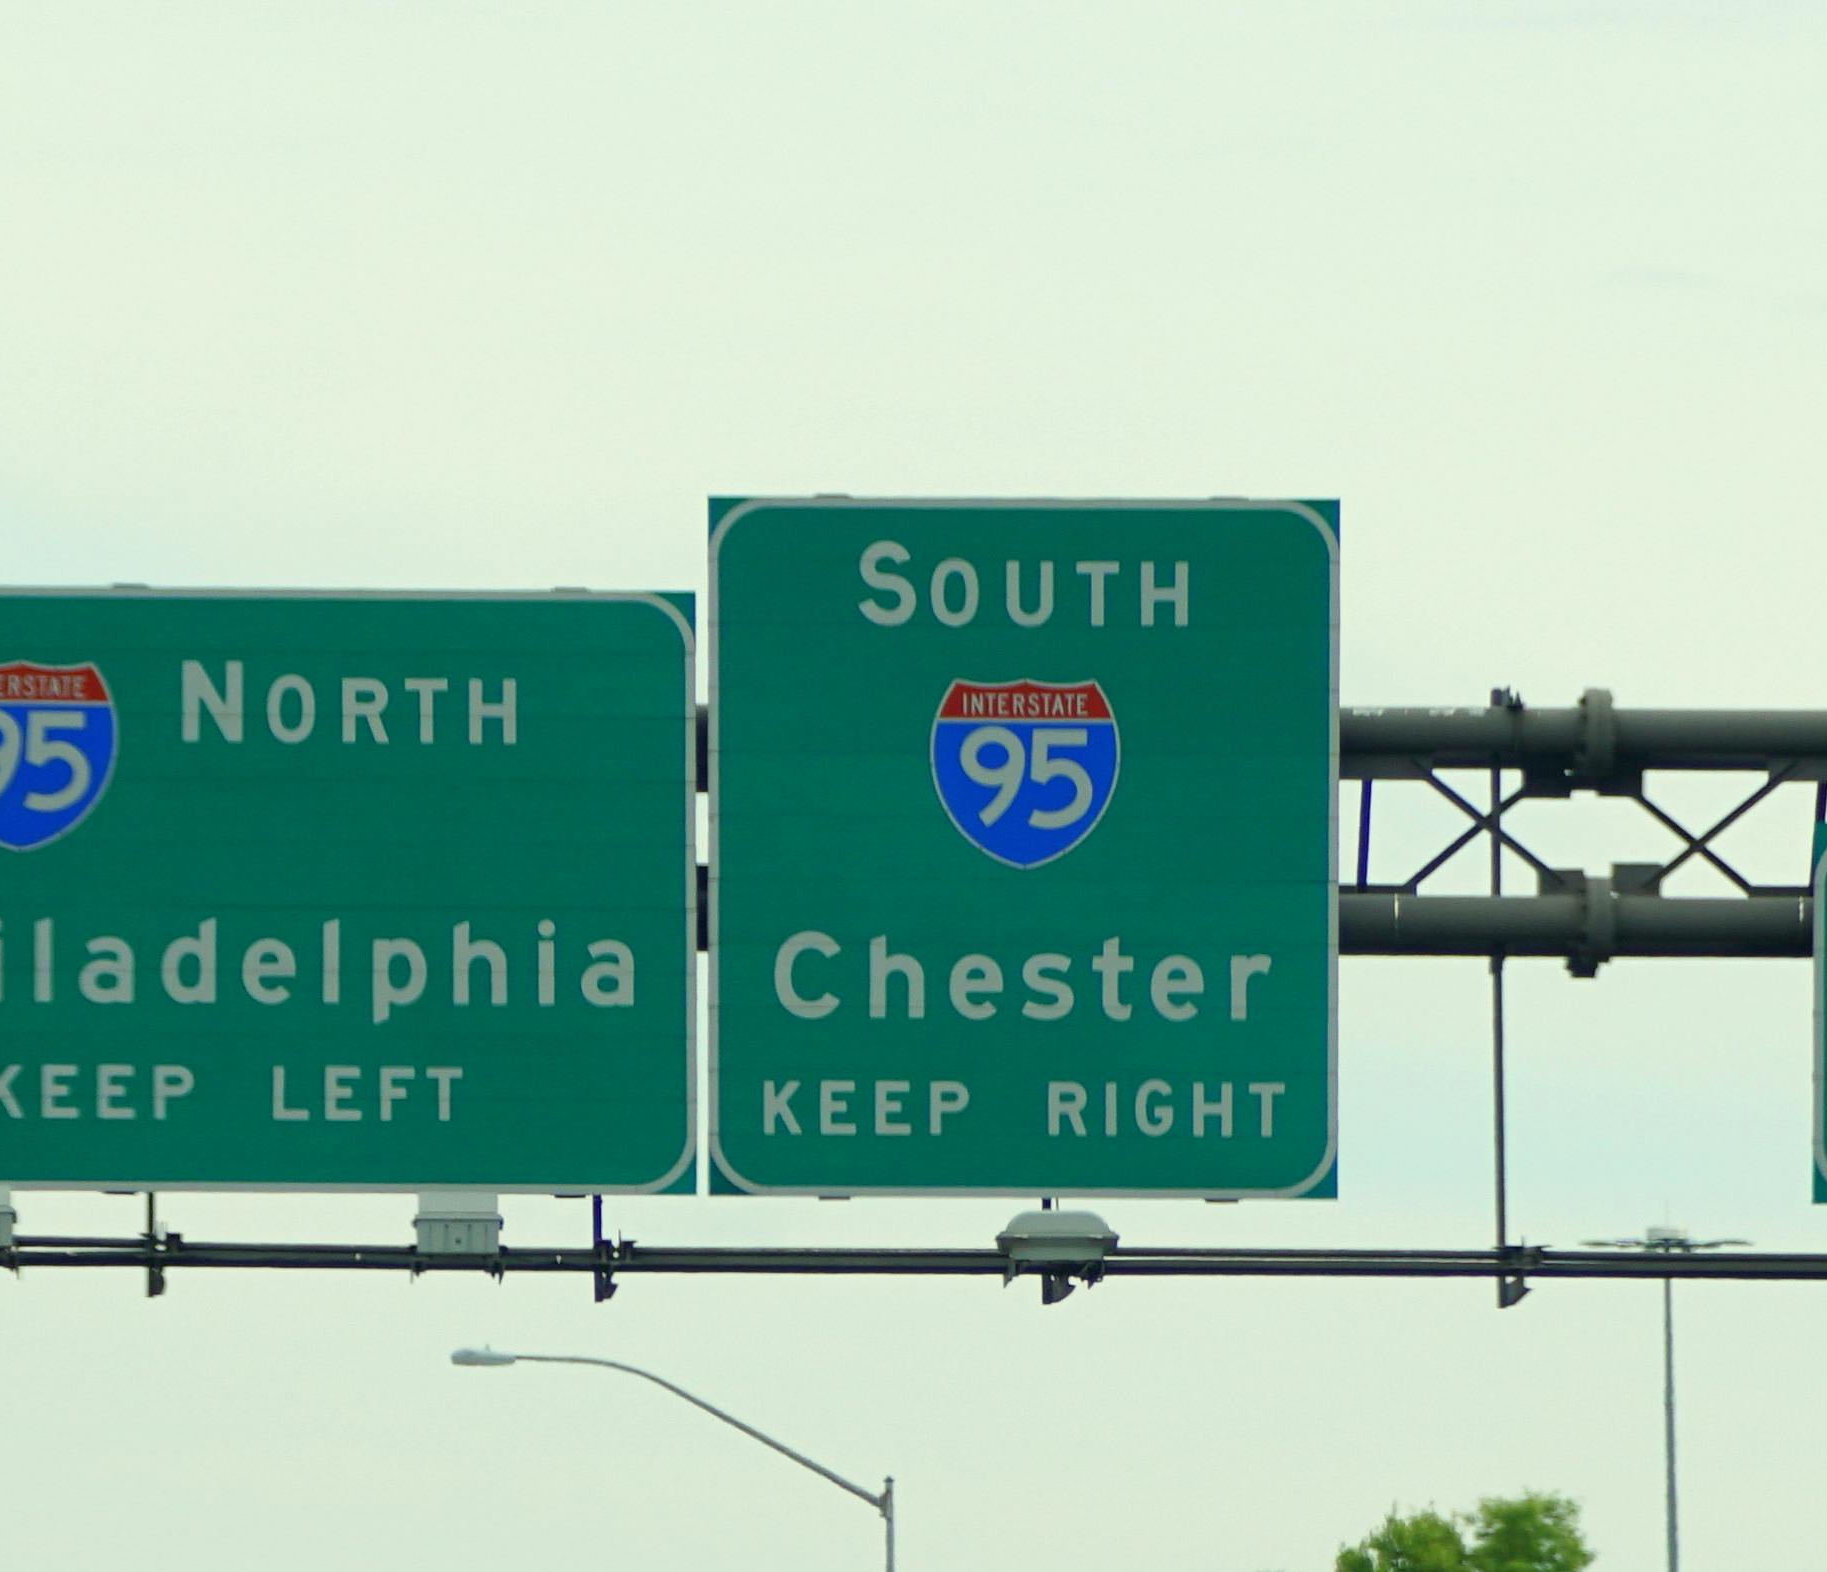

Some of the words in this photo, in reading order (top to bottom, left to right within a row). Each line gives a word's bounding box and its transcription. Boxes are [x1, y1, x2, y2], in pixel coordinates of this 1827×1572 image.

[857, 541, 1189, 627] SOUTH
[181, 660, 518, 745] NORTH
[962, 692, 1088, 717] INTERSTATE
[959, 726, 1094, 829] 95
[774, 931, 1272, 1022] Chester
[273, 1065, 463, 1122] LEFT
[763, 1080, 970, 1136] KEEP
[1048, 1078, 1285, 1137] RIGHT
